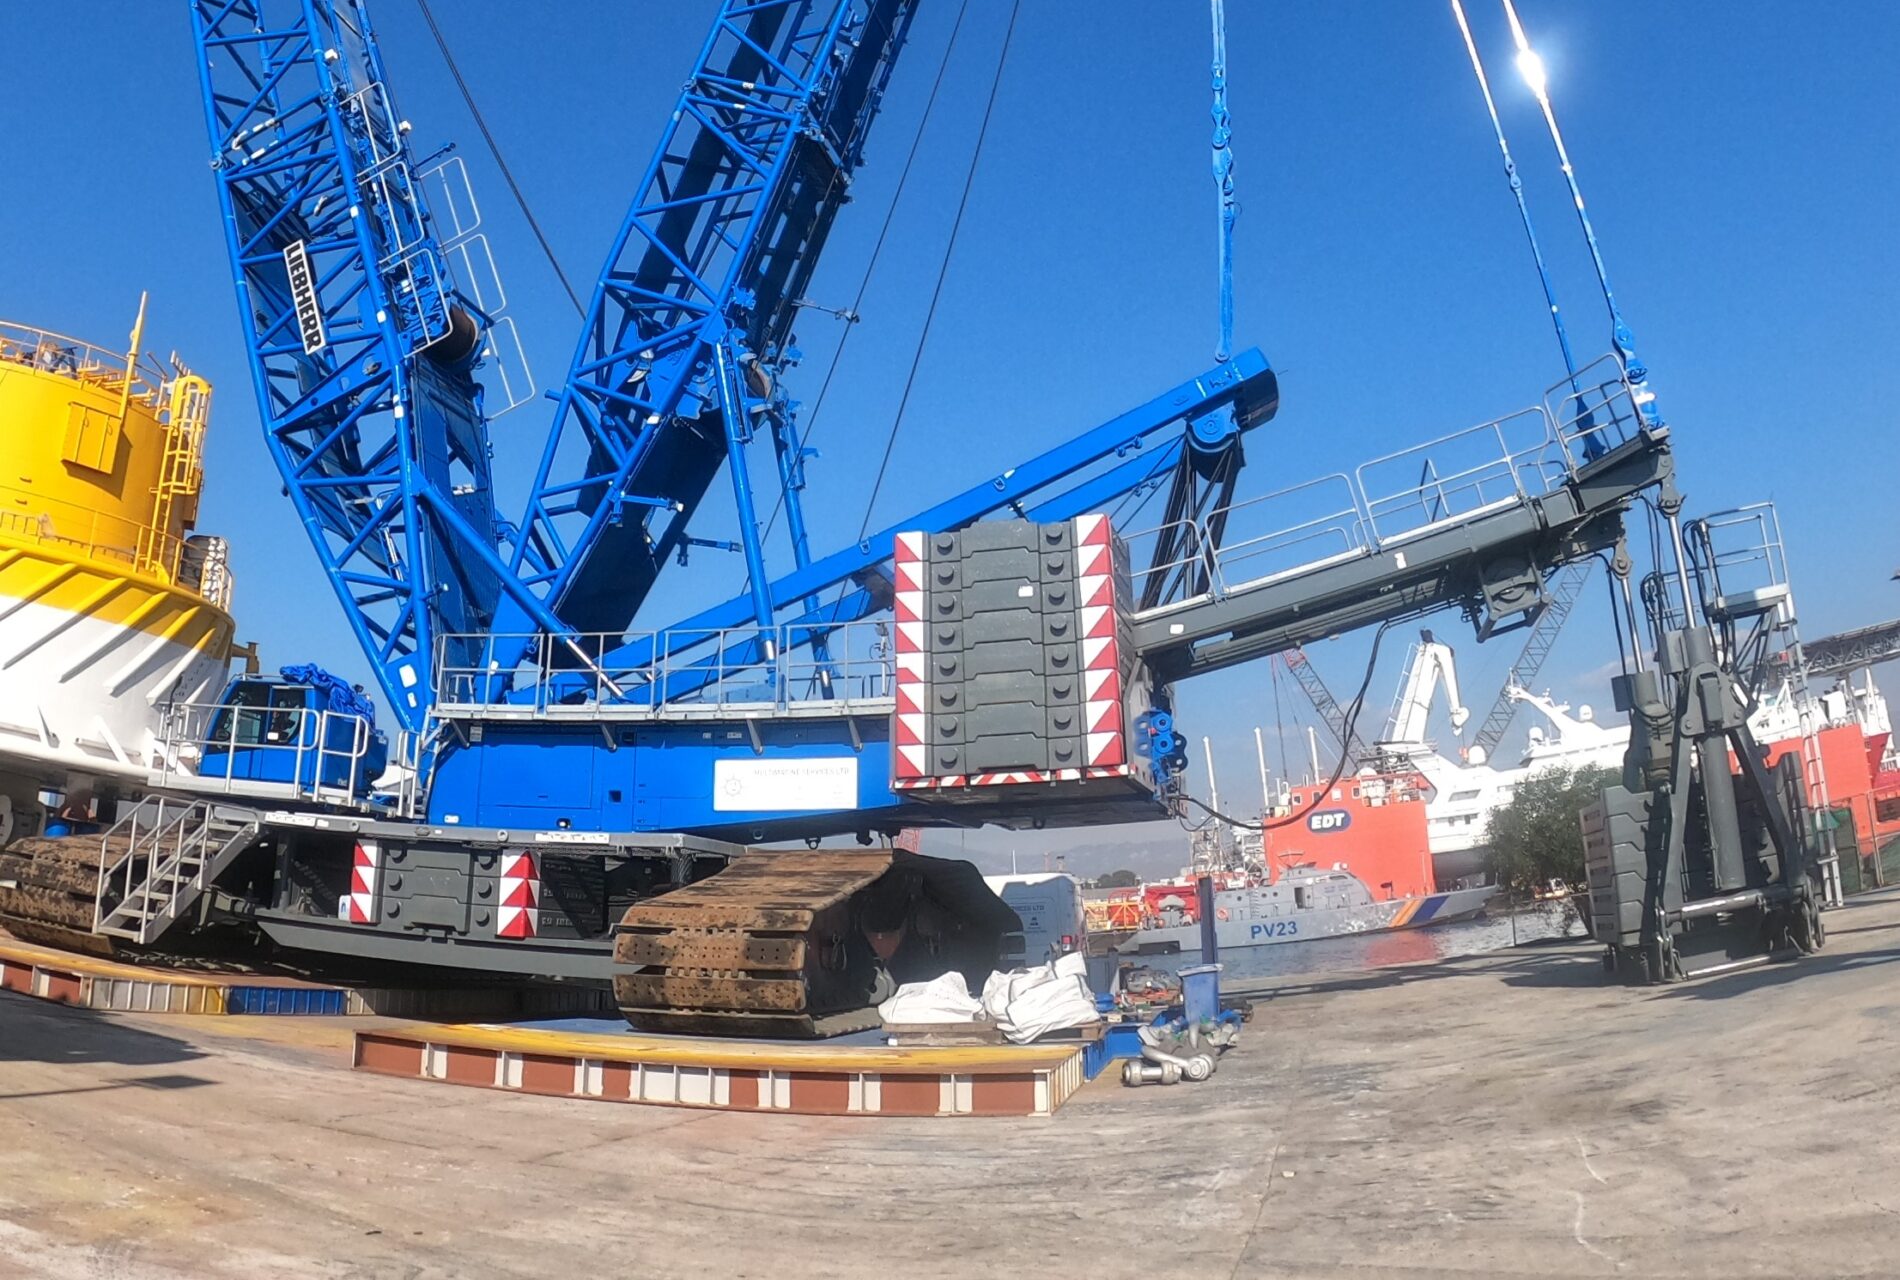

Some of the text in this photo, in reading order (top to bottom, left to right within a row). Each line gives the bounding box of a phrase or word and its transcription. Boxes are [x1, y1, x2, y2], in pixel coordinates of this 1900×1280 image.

[285, 242, 322, 352] LIEBHERR
[836, 766, 850, 776] LTD
[1311, 813, 1345, 830] EDT
[1251, 921, 1298, 939] PV23
